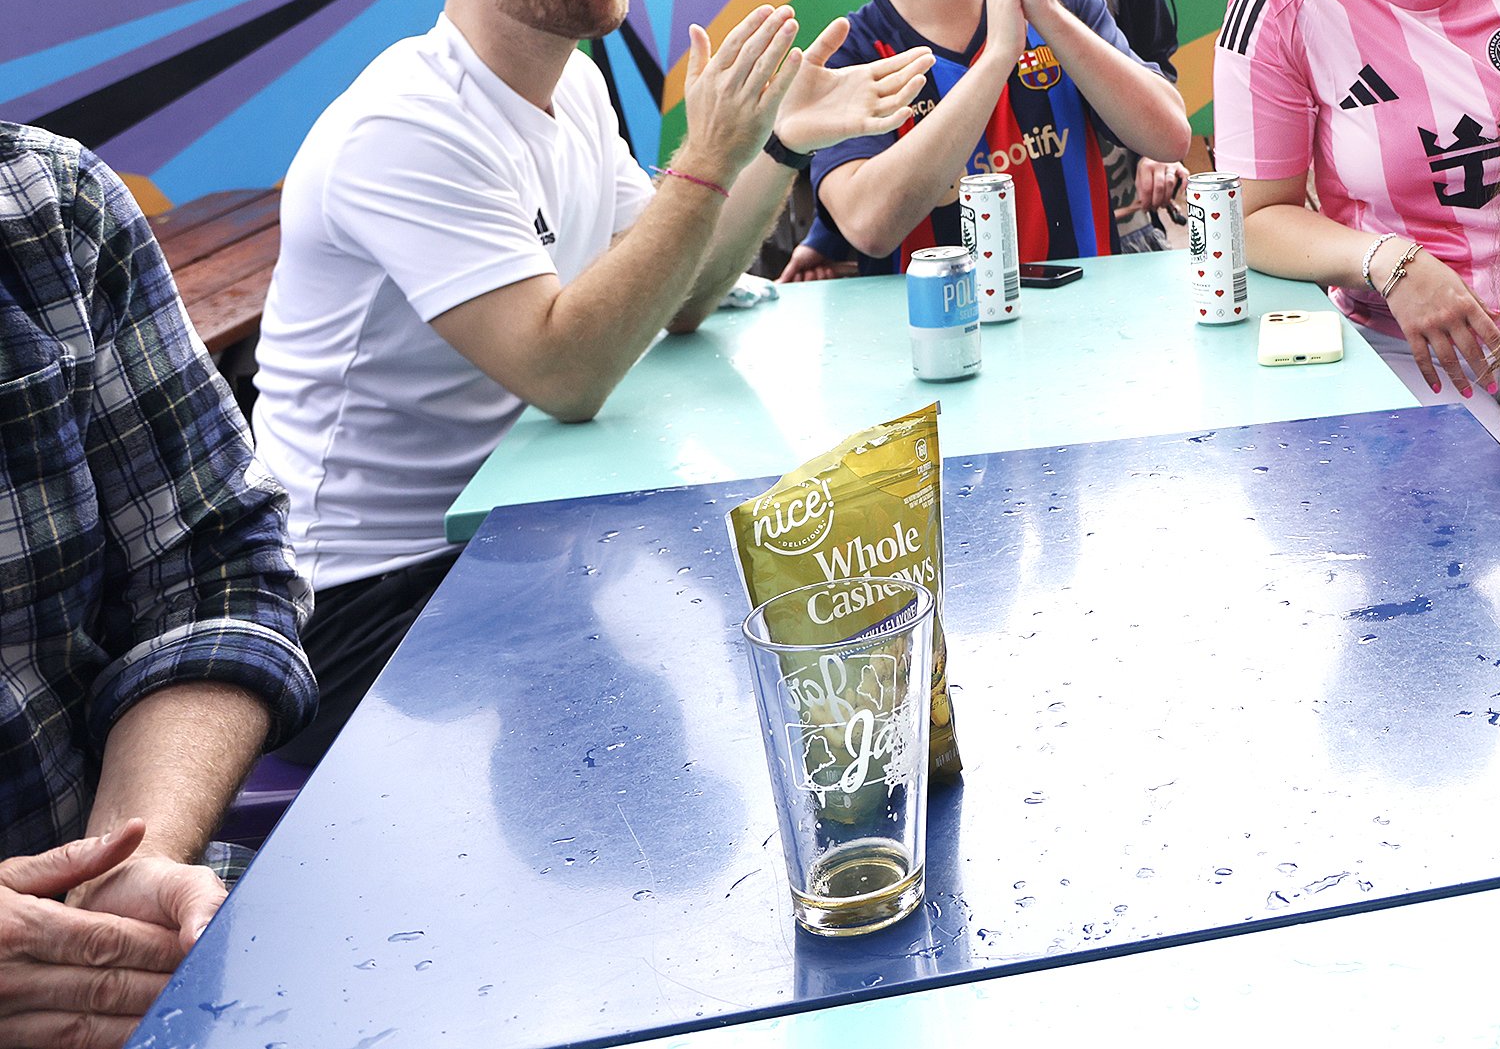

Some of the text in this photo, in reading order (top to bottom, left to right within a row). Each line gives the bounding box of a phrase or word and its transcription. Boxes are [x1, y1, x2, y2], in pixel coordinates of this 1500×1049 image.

[974, 124, 1069, 174] Spotify
[943, 275, 978, 313] POL
[753, 479, 835, 547] nice!
[782, 523, 824, 548] DELICIOUS
[813, 521, 922, 584] Whole
[807, 555, 935, 625] Cashews
